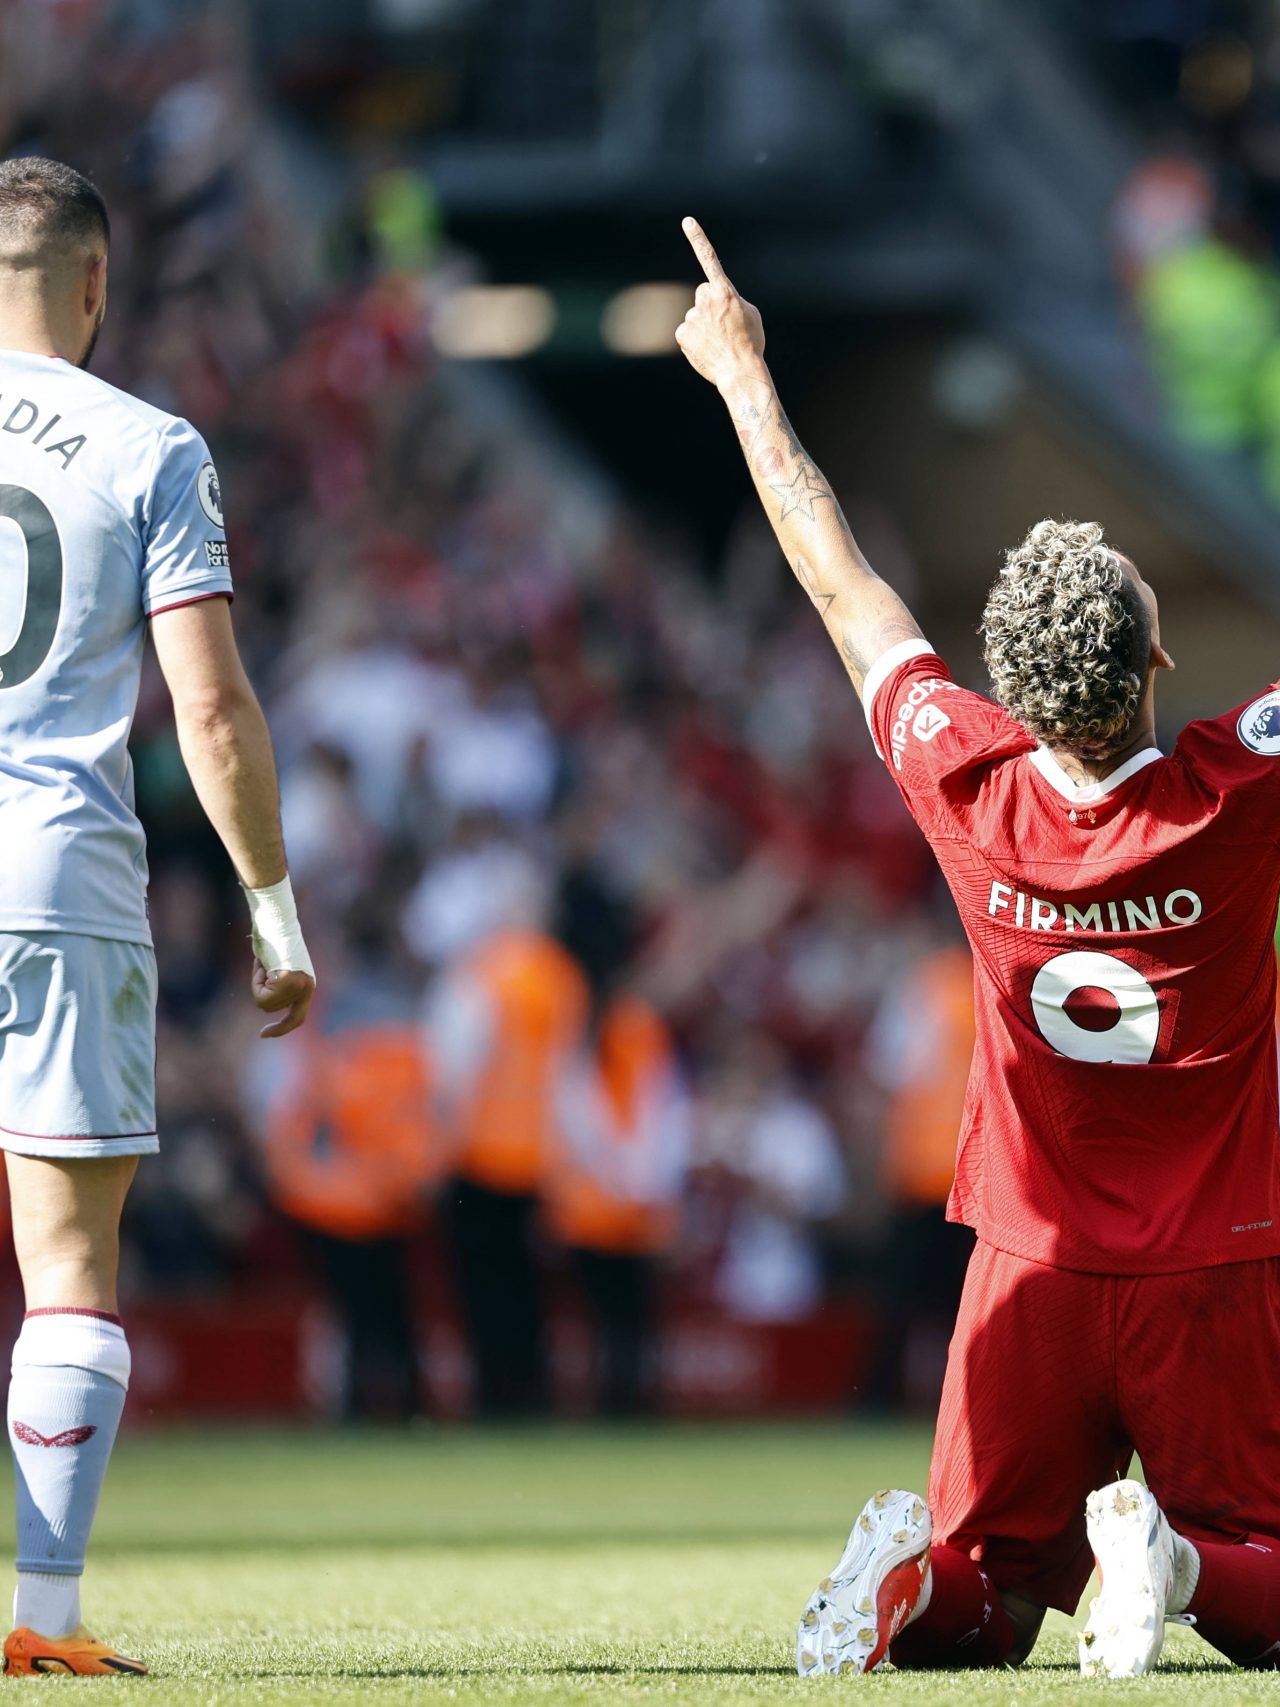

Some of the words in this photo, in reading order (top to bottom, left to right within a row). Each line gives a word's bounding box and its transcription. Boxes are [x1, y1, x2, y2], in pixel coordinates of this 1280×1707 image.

[0, 394, 87, 471] DIA
[988, 880, 1203, 933] FIRMINO
[1030, 950, 1161, 1065] 9
